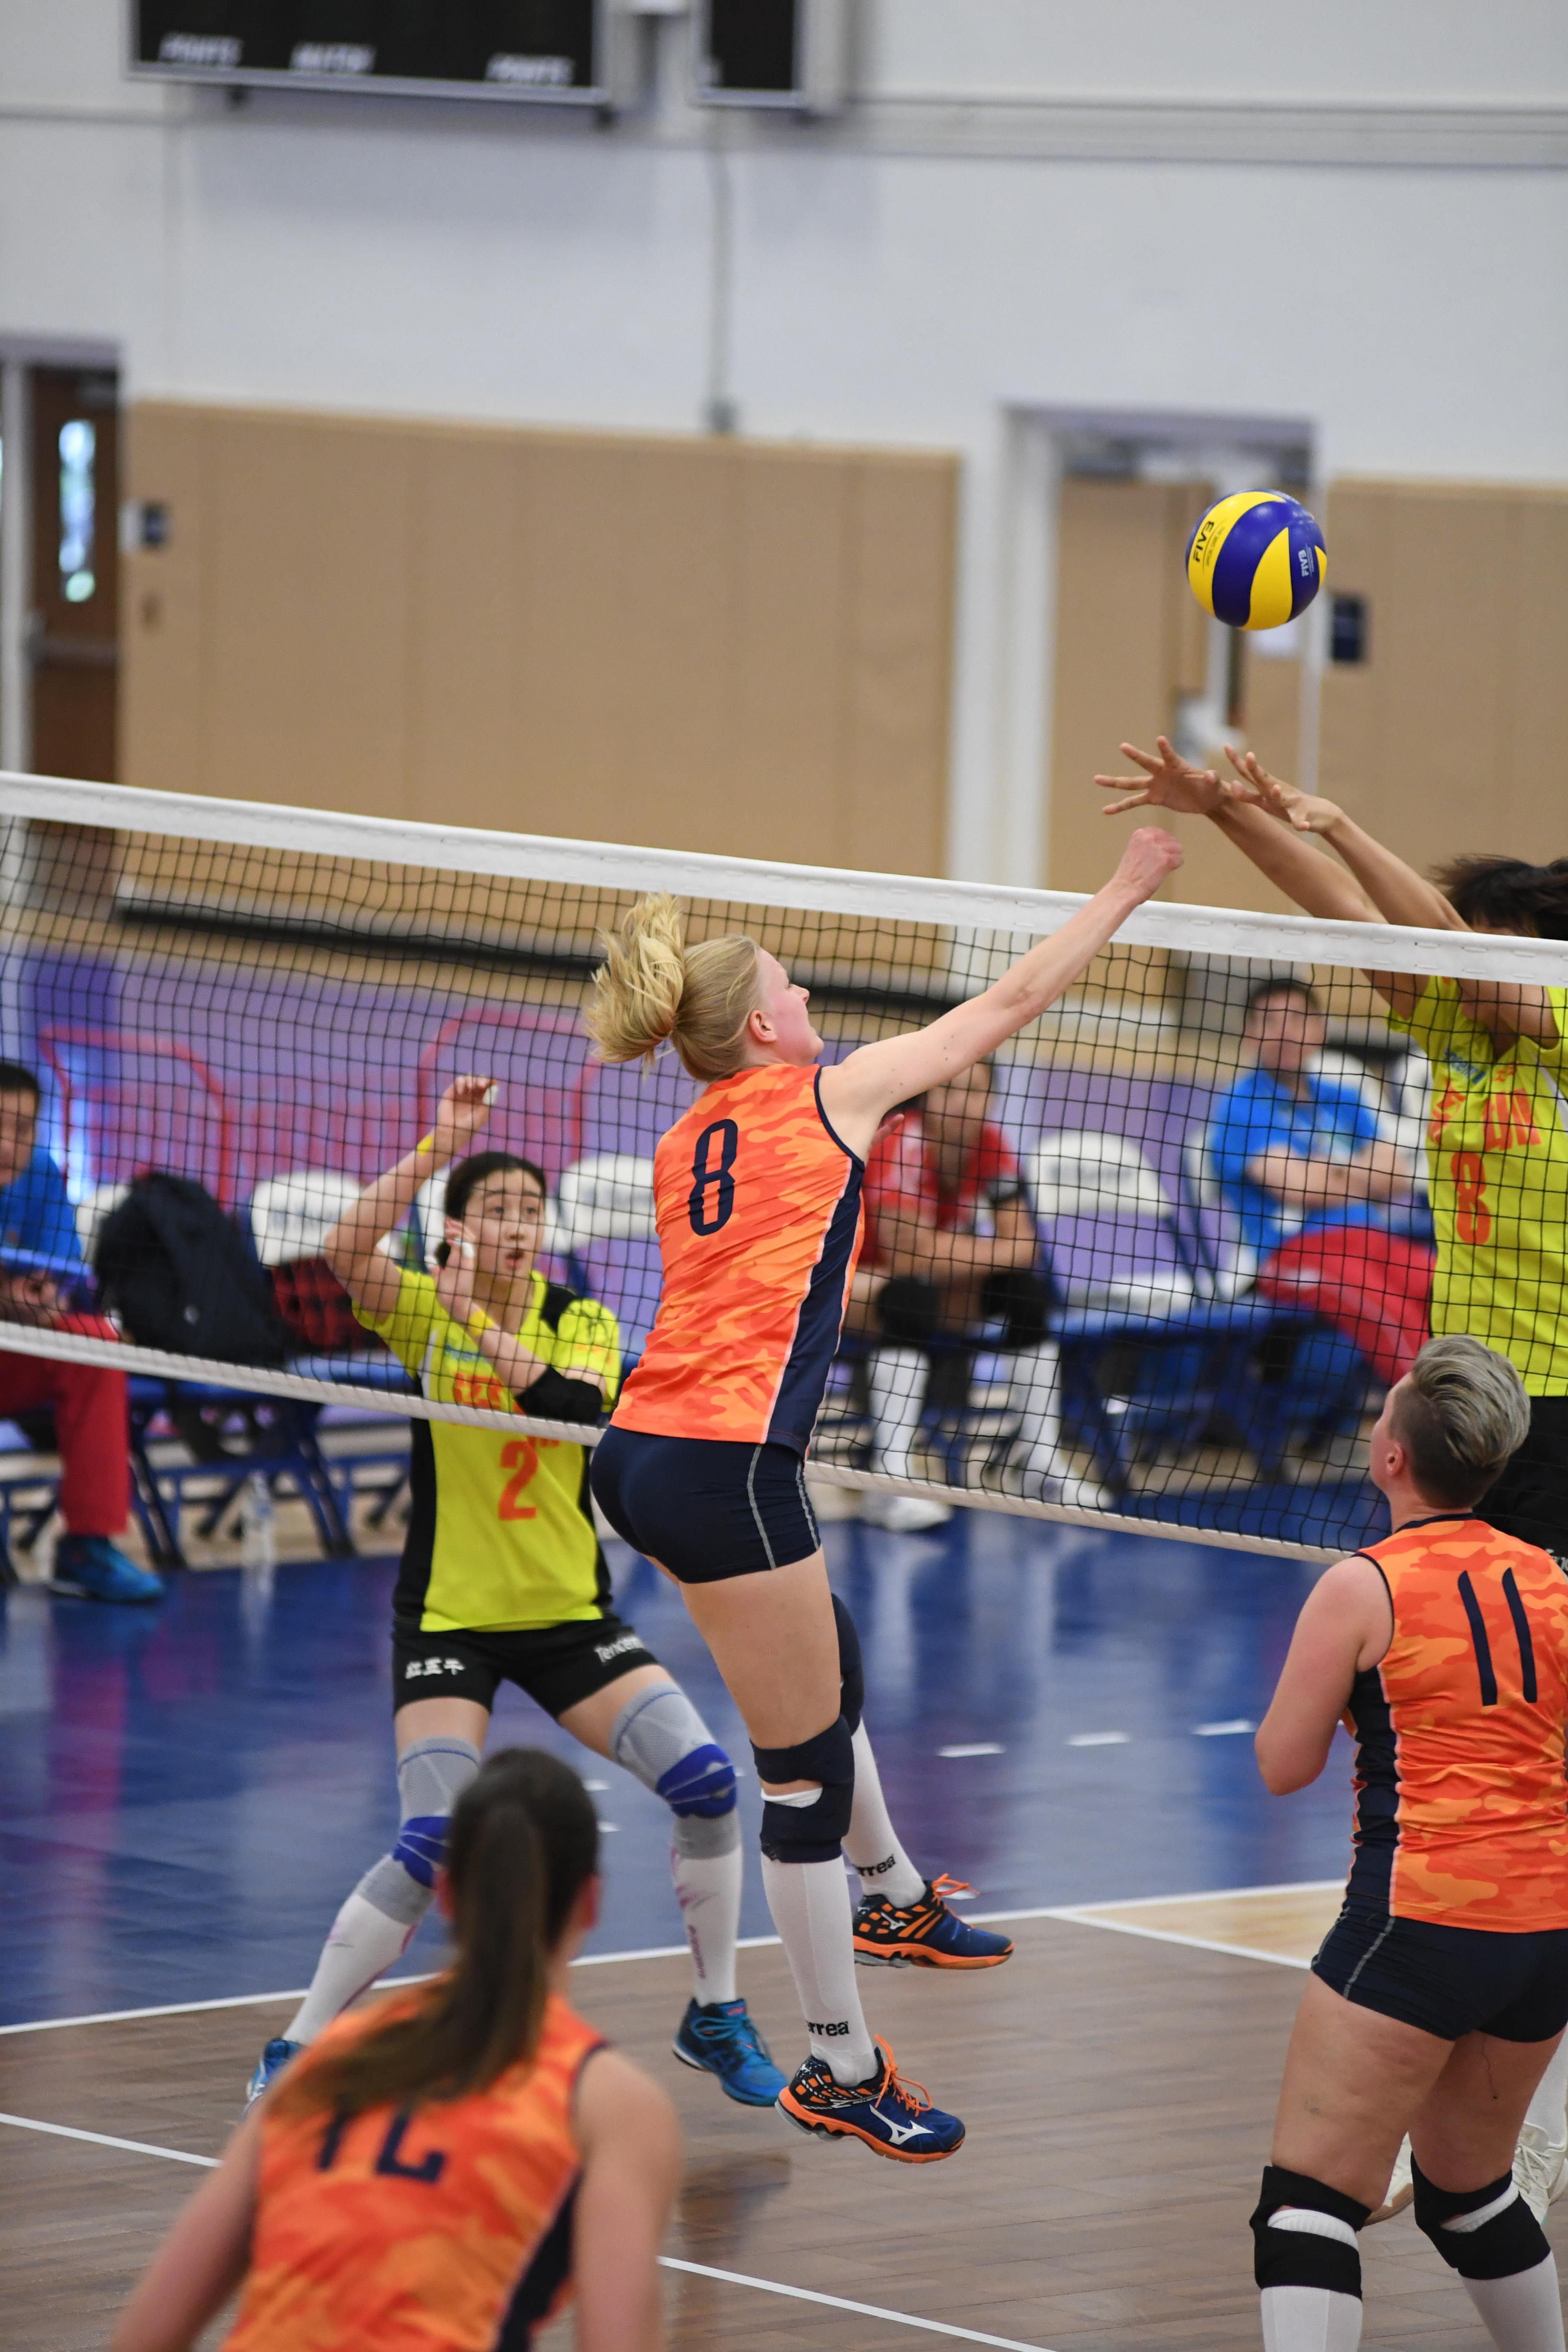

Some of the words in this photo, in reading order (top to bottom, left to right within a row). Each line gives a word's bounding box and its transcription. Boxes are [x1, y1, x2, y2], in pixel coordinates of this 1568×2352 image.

[688, 1119, 738, 1236] 8
[1450, 1151, 1492, 1245] 8
[498, 1440, 539, 1521] 2
[1458, 1567, 1537, 1707] 11
